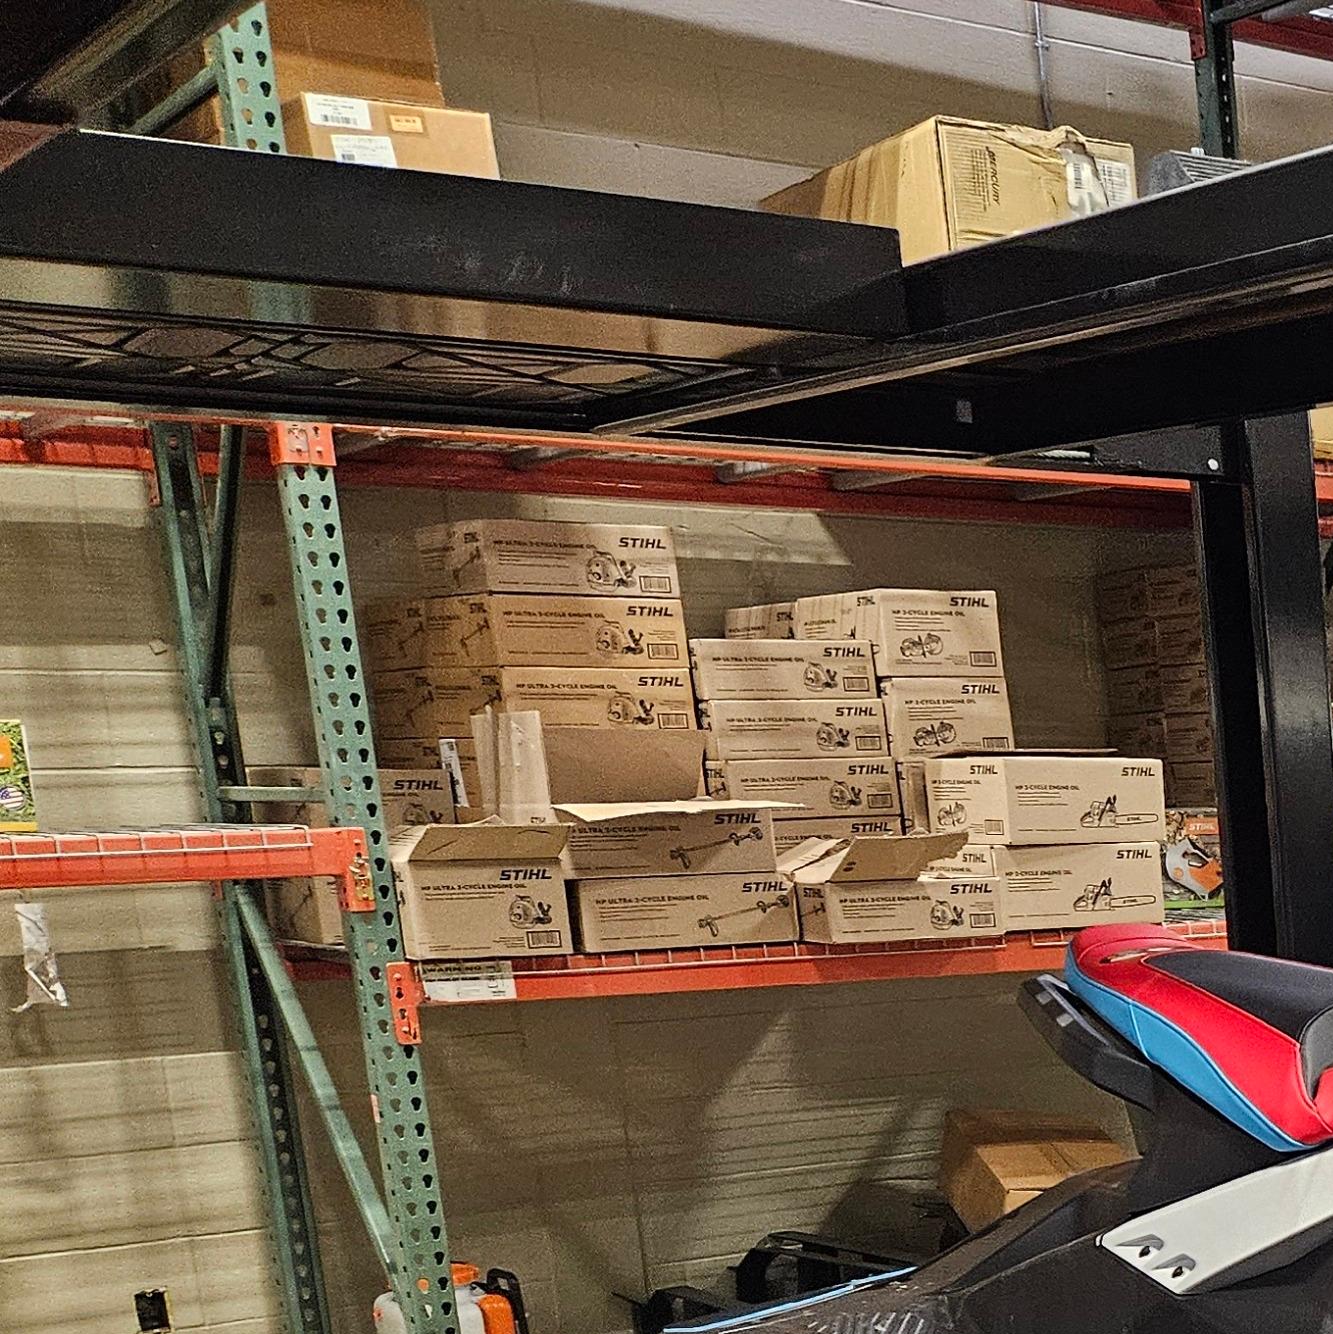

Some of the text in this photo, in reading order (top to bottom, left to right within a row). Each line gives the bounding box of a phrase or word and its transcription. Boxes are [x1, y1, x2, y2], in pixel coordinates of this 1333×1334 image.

[619, 537, 667, 549] STIHL
[950, 597, 989, 607] STIHL
[626, 606, 674, 617] STIHL
[823, 647, 865, 658] STIHL
[637, 676, 684, 687] STIHL
[961, 685, 1000, 694] STIHL
[835, 707, 877, 717] STIHL
[848, 765, 888, 775] STIHL
[970, 765, 998, 775] STIHL
[1121, 767, 1155, 777] STIHL
[394, 780, 443, 790] STIHL
[714, 814, 761, 824] STIHL
[851, 823, 893, 832] STIHL
[1189, 822, 1215, 831] STIHL
[962, 853, 986, 863] STIHL
[1116, 850, 1152, 859] STIHL
[500, 869, 552, 880] STIHL
[742, 881, 787, 892] STIHL
[950, 883, 992, 894] STIHL
[427, 966, 482, 974] WARNNG
